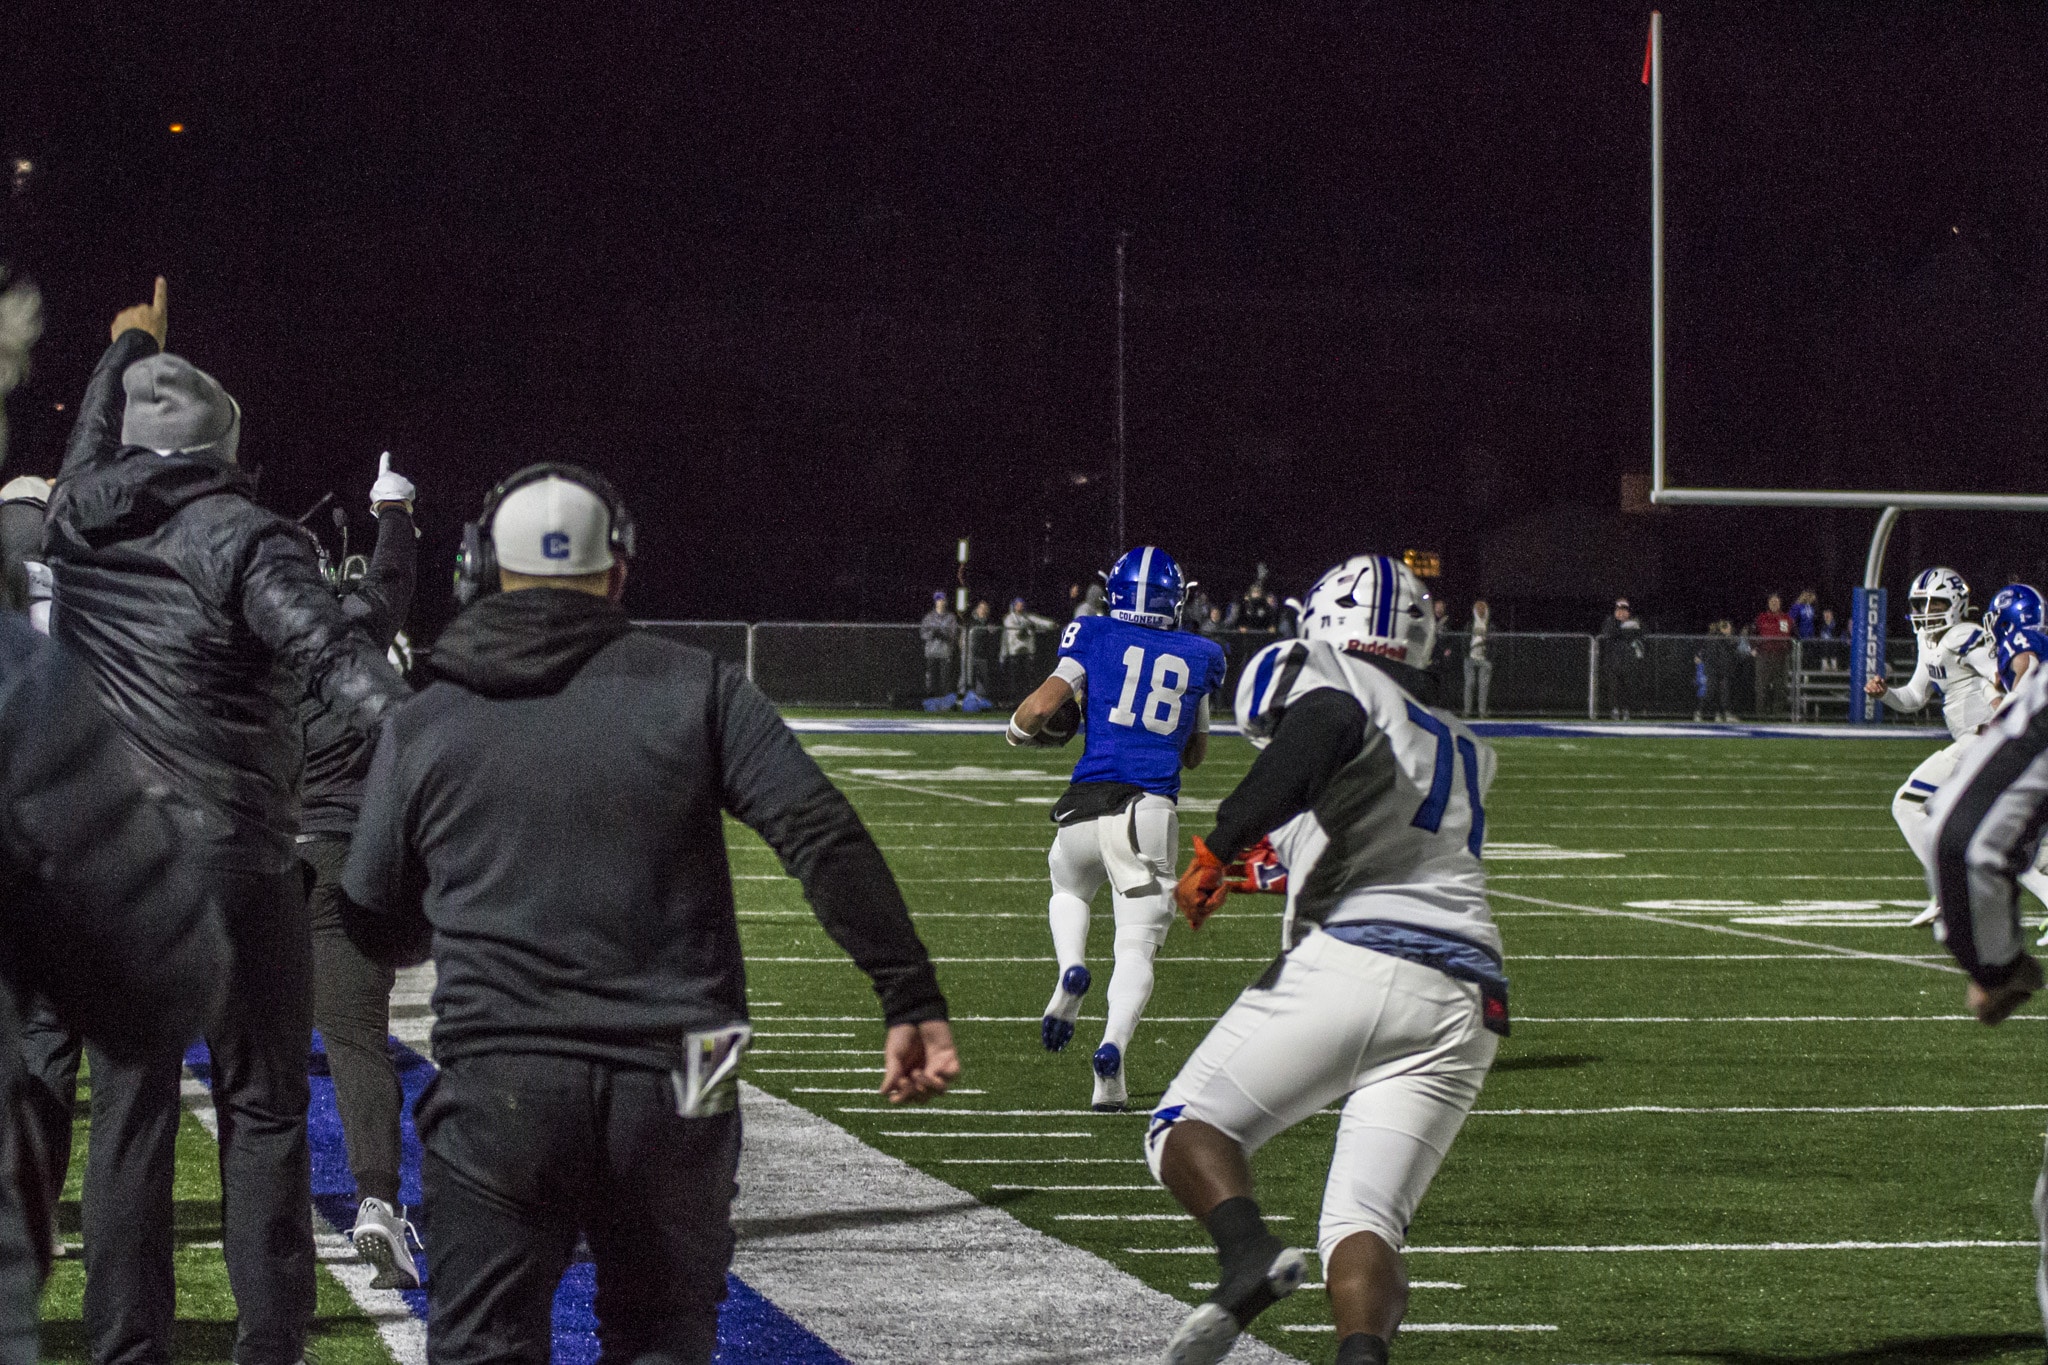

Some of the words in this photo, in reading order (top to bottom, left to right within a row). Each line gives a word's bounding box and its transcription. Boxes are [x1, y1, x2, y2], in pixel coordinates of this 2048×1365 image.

[541, 532, 570, 559] C
[1119, 611, 1163, 624] COLONELS
[1348, 639, 1407, 661] Riddell
[2003, 631, 2031, 657] 14
[1108, 645, 1190, 736] 18
